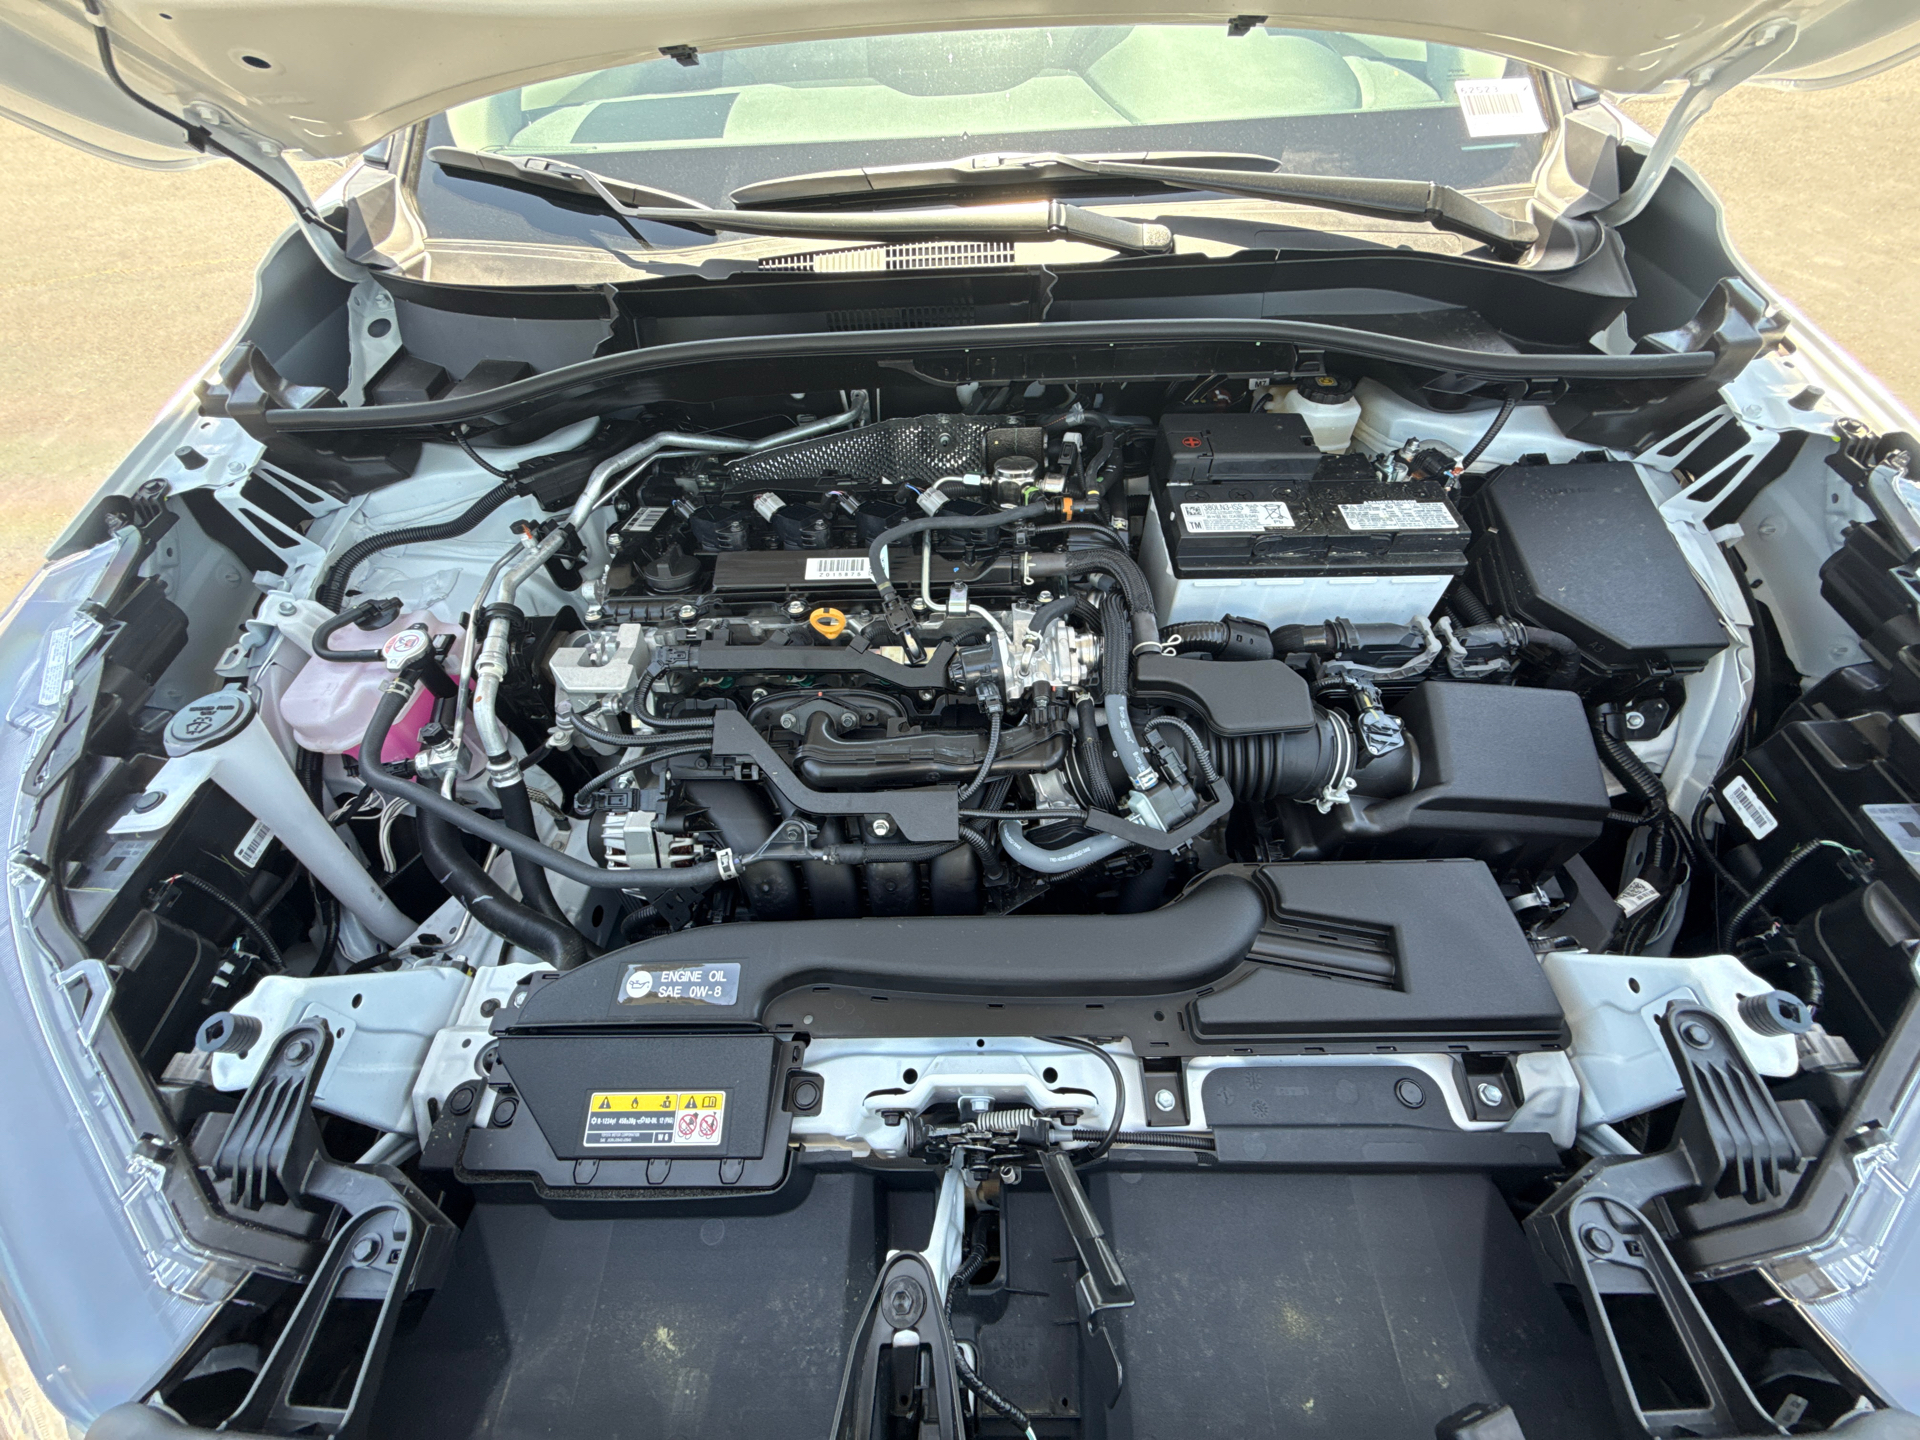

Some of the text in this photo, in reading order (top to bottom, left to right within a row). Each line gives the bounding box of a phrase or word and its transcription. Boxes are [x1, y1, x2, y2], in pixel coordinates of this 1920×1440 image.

[1189, 522, 1202, 530] TM
[660, 970, 727, 983] ENGINE OIL
[658, 985, 722, 998] SAE 0W-8
